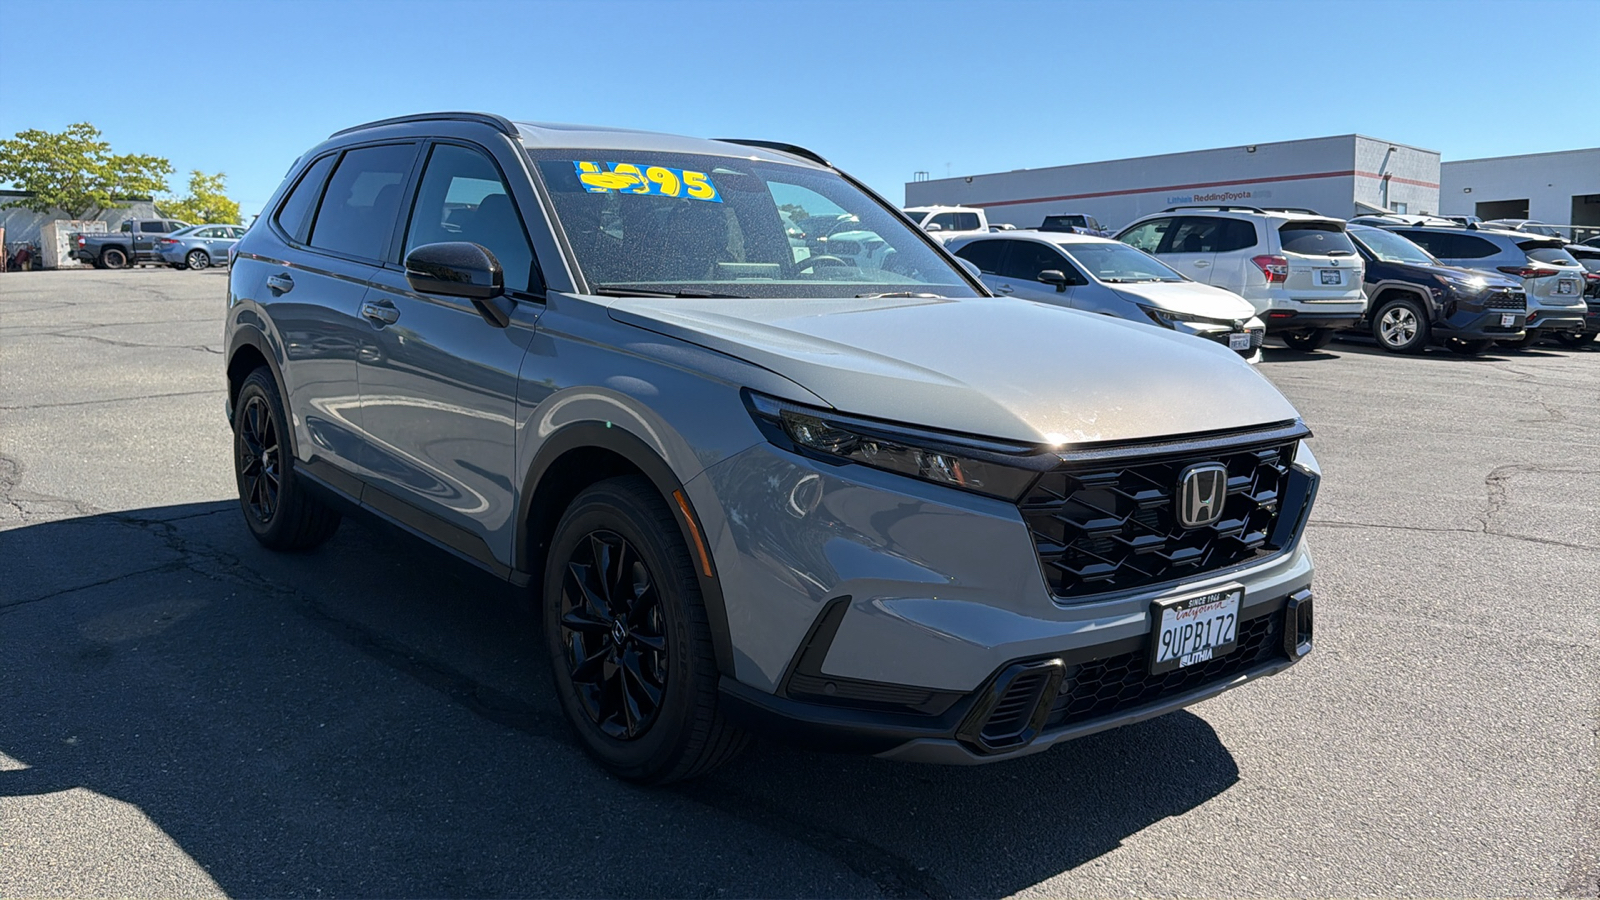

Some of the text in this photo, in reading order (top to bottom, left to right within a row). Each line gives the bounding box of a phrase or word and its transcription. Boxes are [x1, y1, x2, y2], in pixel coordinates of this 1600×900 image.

[1193, 191, 1251, 203] ReddingToyota
[1188, 596, 1205, 607] SINCE
[1176, 602, 1226, 620] California
[1161, 613, 1235, 661] 9UPB172
